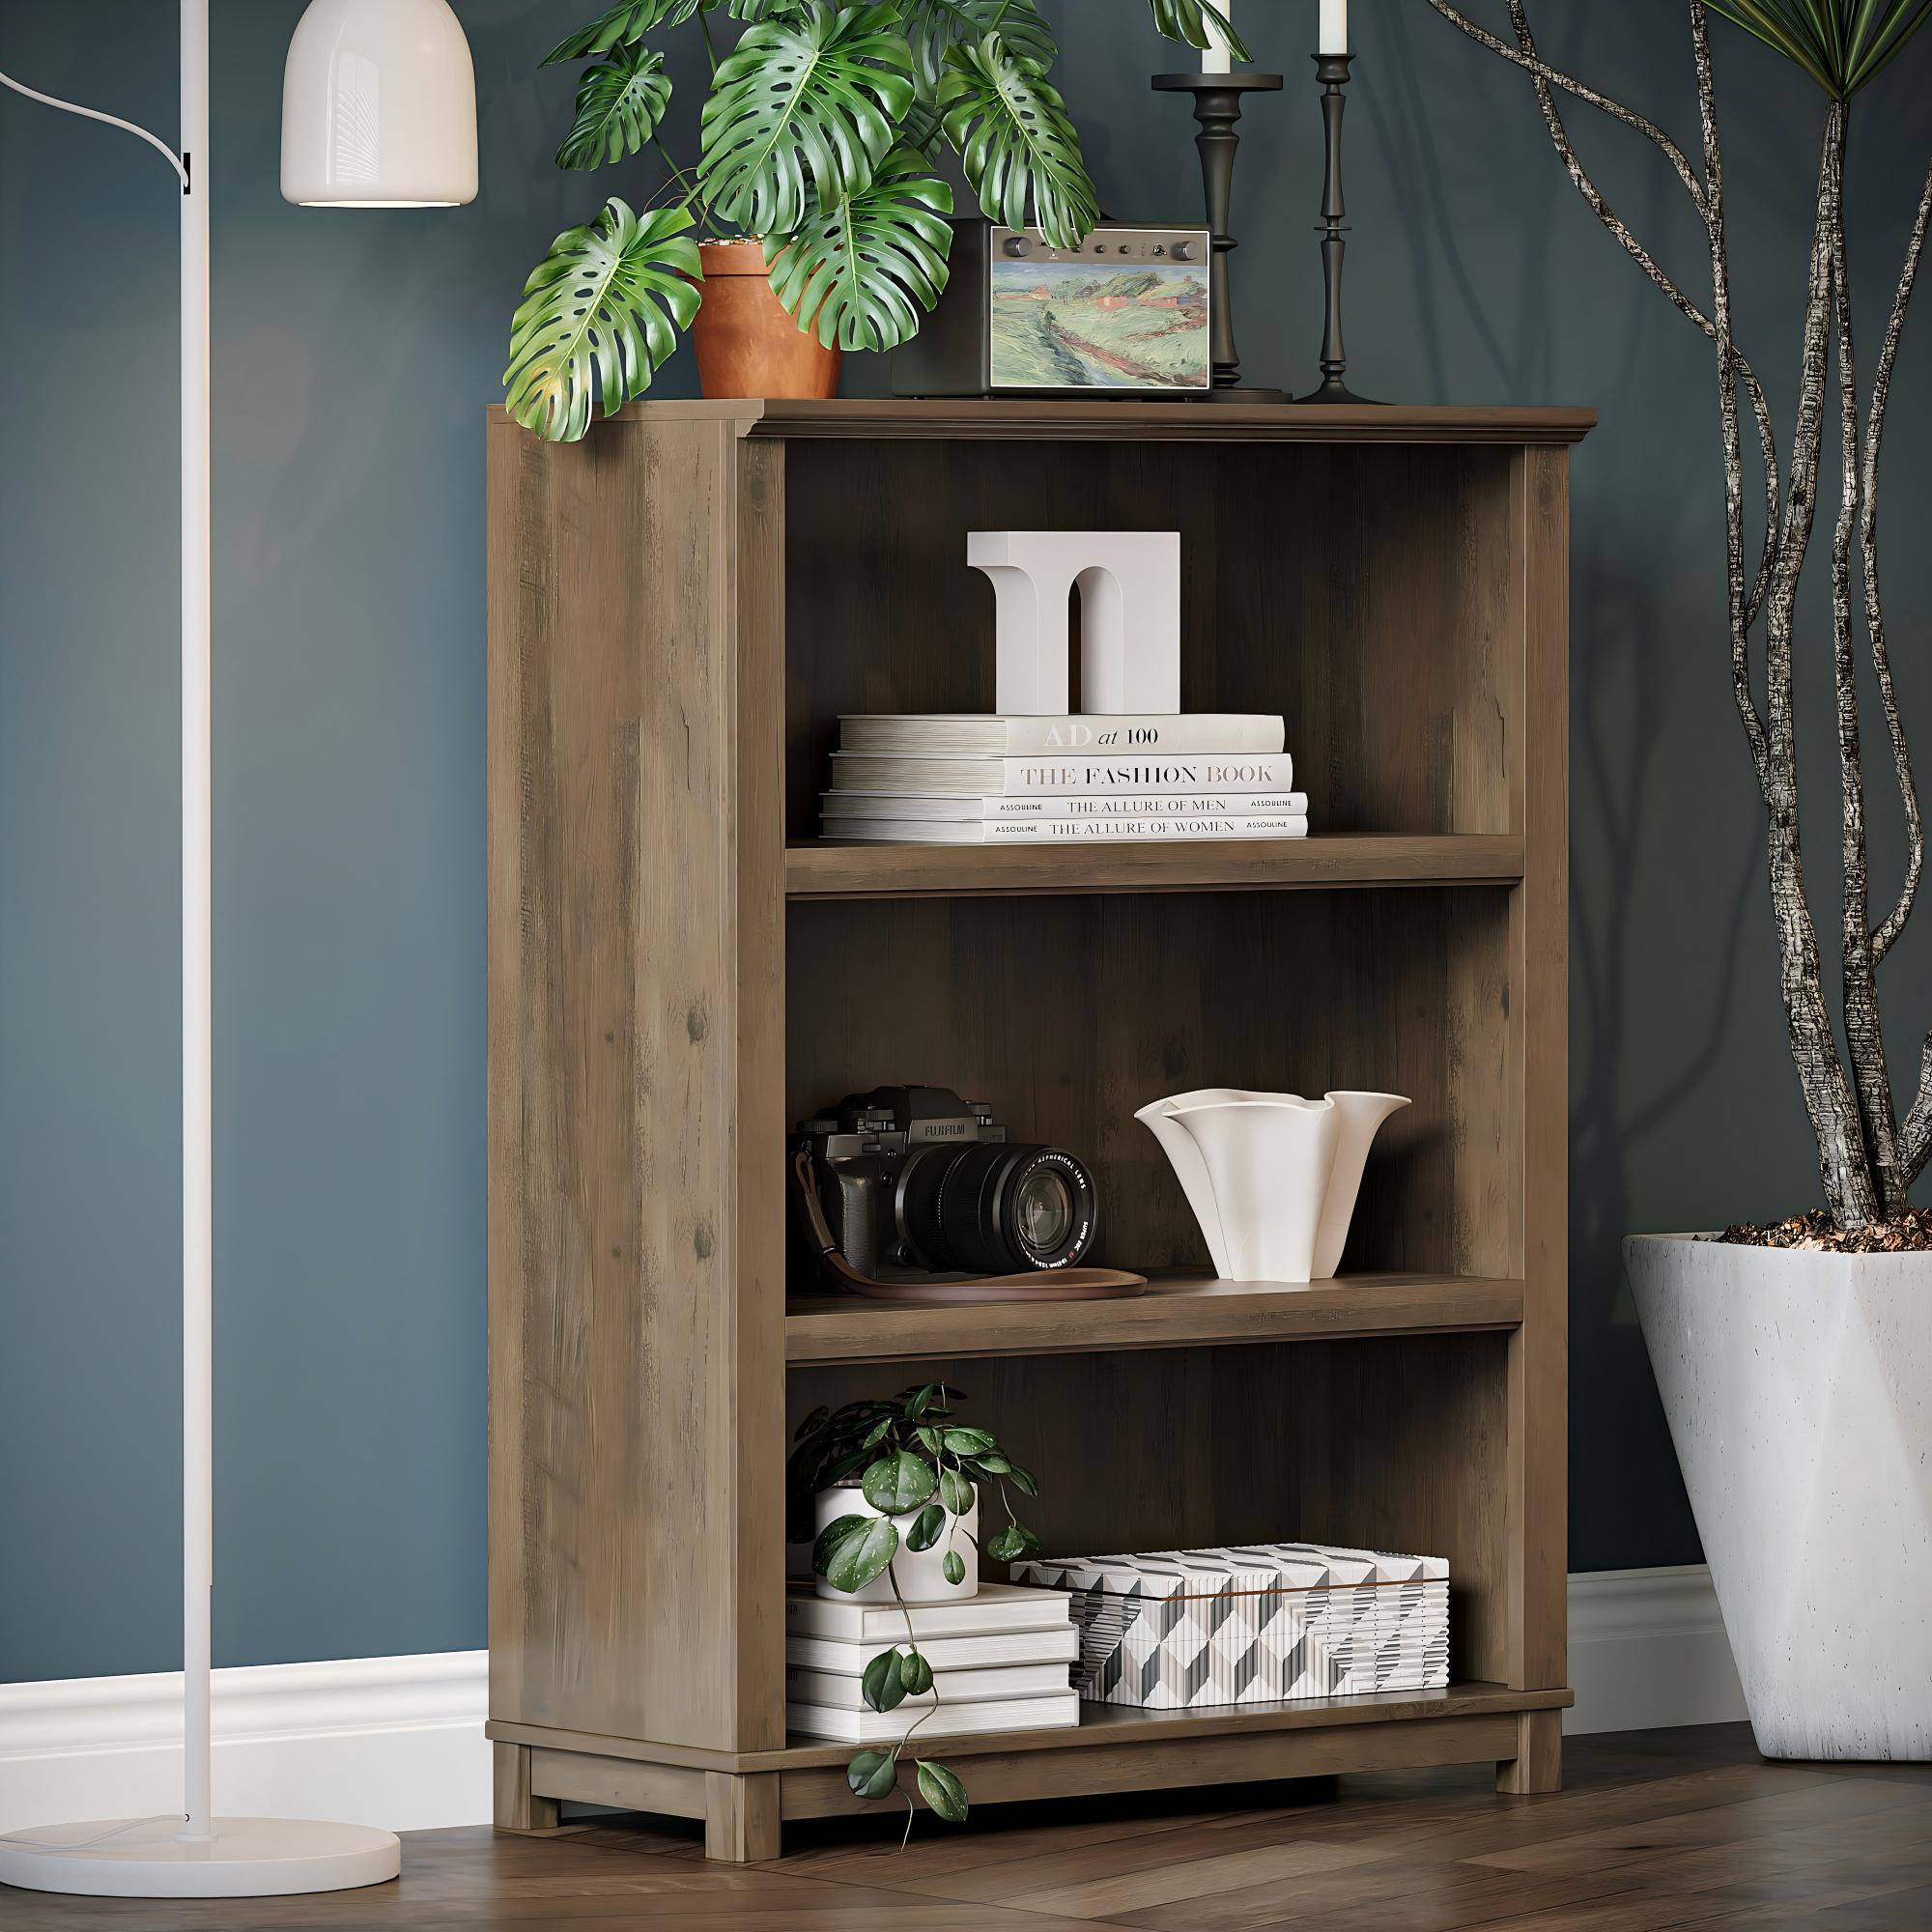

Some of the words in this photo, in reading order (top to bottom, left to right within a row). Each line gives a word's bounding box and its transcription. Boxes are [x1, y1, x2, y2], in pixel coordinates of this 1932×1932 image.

[1043, 724, 1092, 747] AD
[1097, 728, 1120, 745] at
[1126, 727, 1158, 744] 100
[1020, 767, 1076, 785] THE
[1086, 766, 1197, 784] FASHION
[1207, 765, 1274, 782] BOOK
[1066, 802, 1098, 812] THE
[1101, 801, 1165, 812] ALLURE
[1167, 800, 1188, 811] OF
[1192, 800, 1227, 811] MEN
[1049, 824, 1080, 835] THE
[1083, 823, 1145, 835] ALLURE
[1151, 822, 1170, 834] OF
[1175, 821, 1235, 833] WOMEN
[924, 1124, 965, 1137] FUJIFILM
[1037, 1153, 1074, 1170] ASPHERICAL
[1074, 1169, 1087, 1189] LENS
